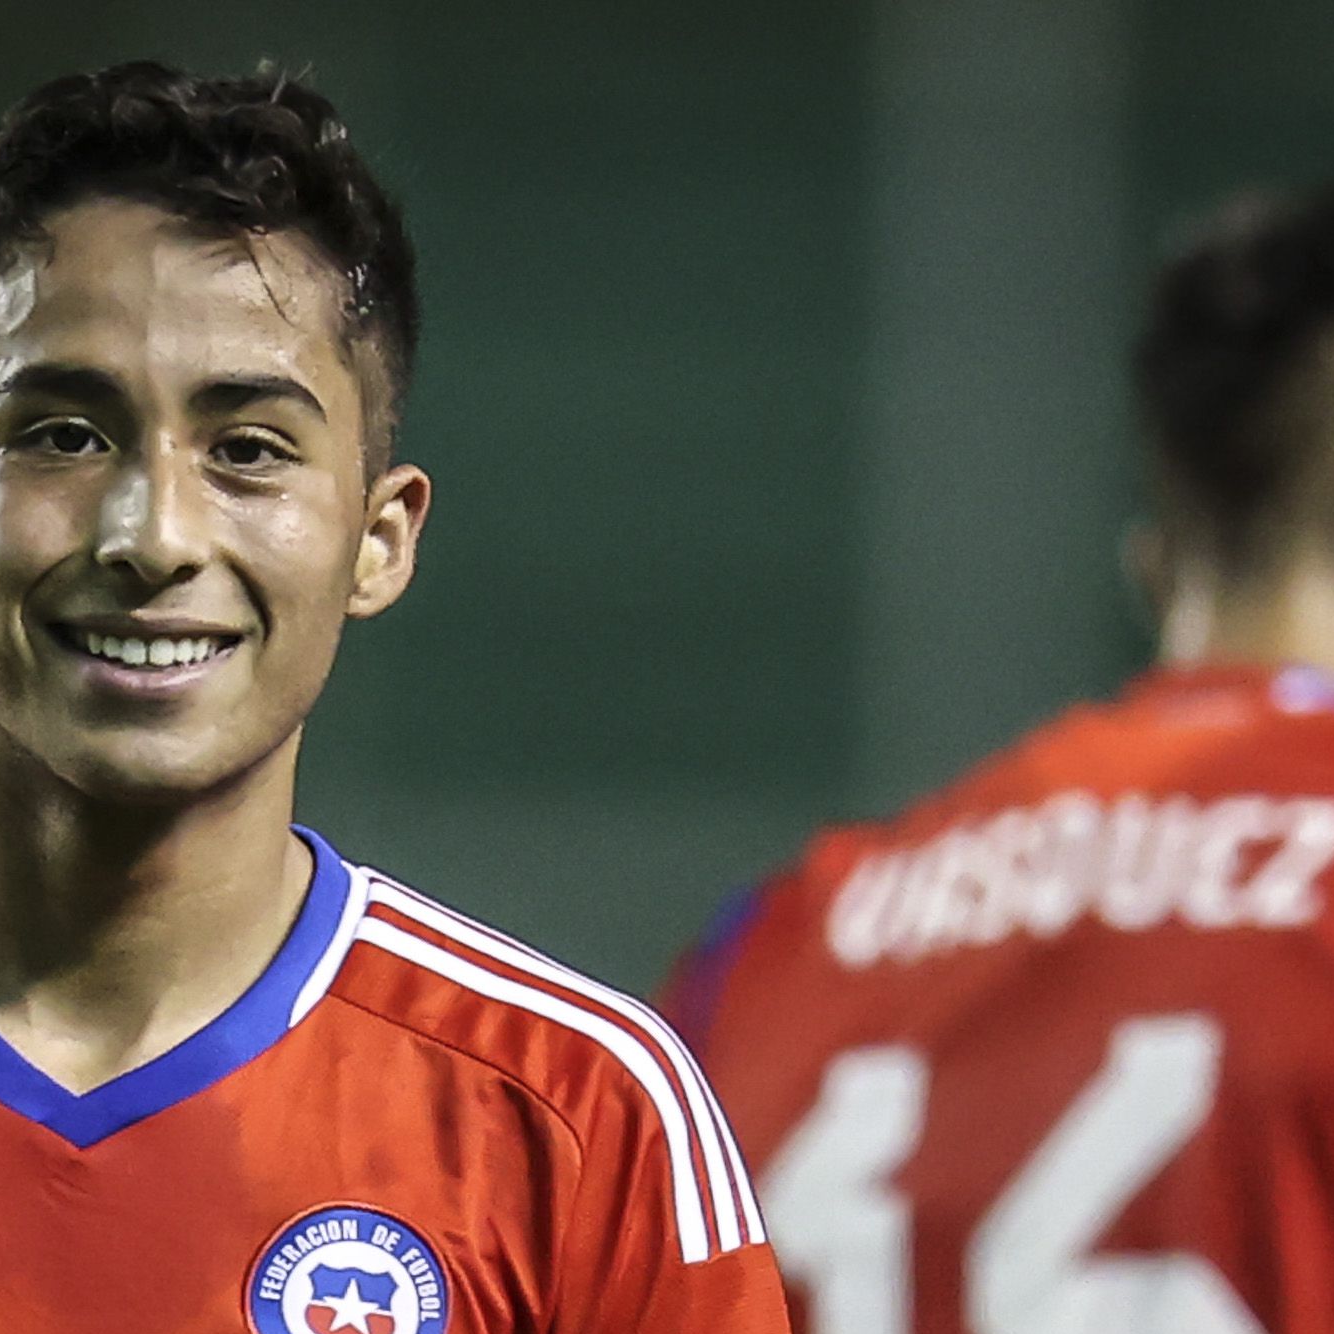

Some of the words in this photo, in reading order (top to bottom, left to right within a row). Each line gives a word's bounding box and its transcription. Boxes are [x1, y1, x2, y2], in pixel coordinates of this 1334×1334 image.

[259, 1219, 358, 1300] FEDERACION
[372, 1224, 401, 1251] DE
[400, 1248, 440, 1321] FUTBOL
